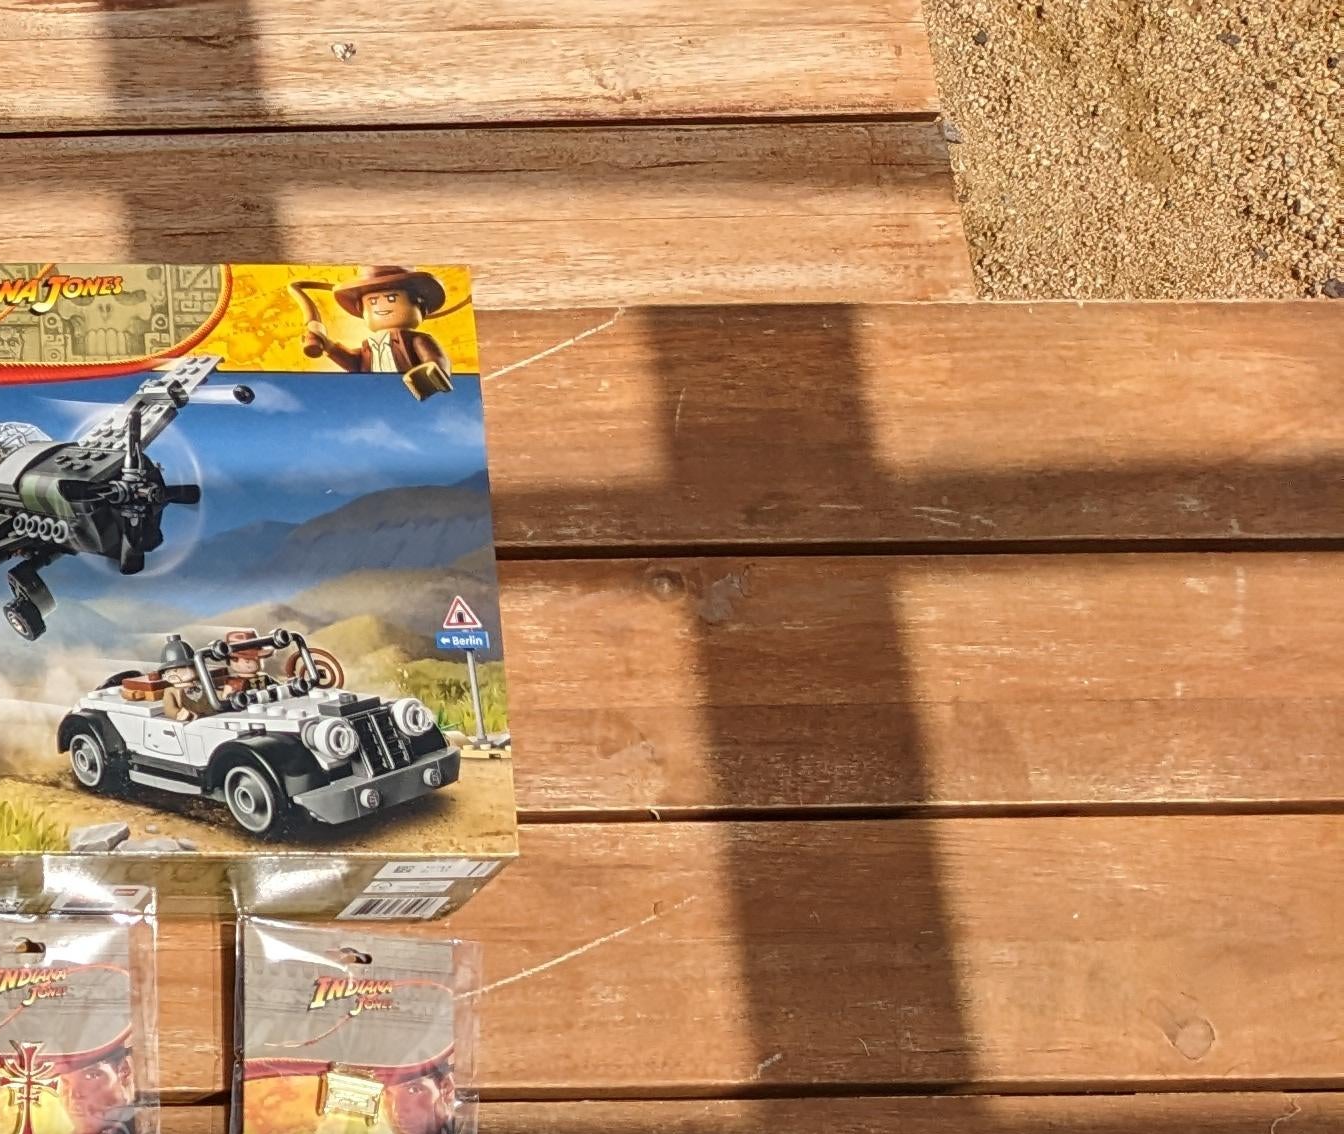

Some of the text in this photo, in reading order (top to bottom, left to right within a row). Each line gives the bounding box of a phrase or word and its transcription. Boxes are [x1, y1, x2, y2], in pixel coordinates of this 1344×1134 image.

[31, 274, 124, 318] JONES
[452, 635, 483, 646] Berlin
[307, 976, 393, 1011] INDIANA
